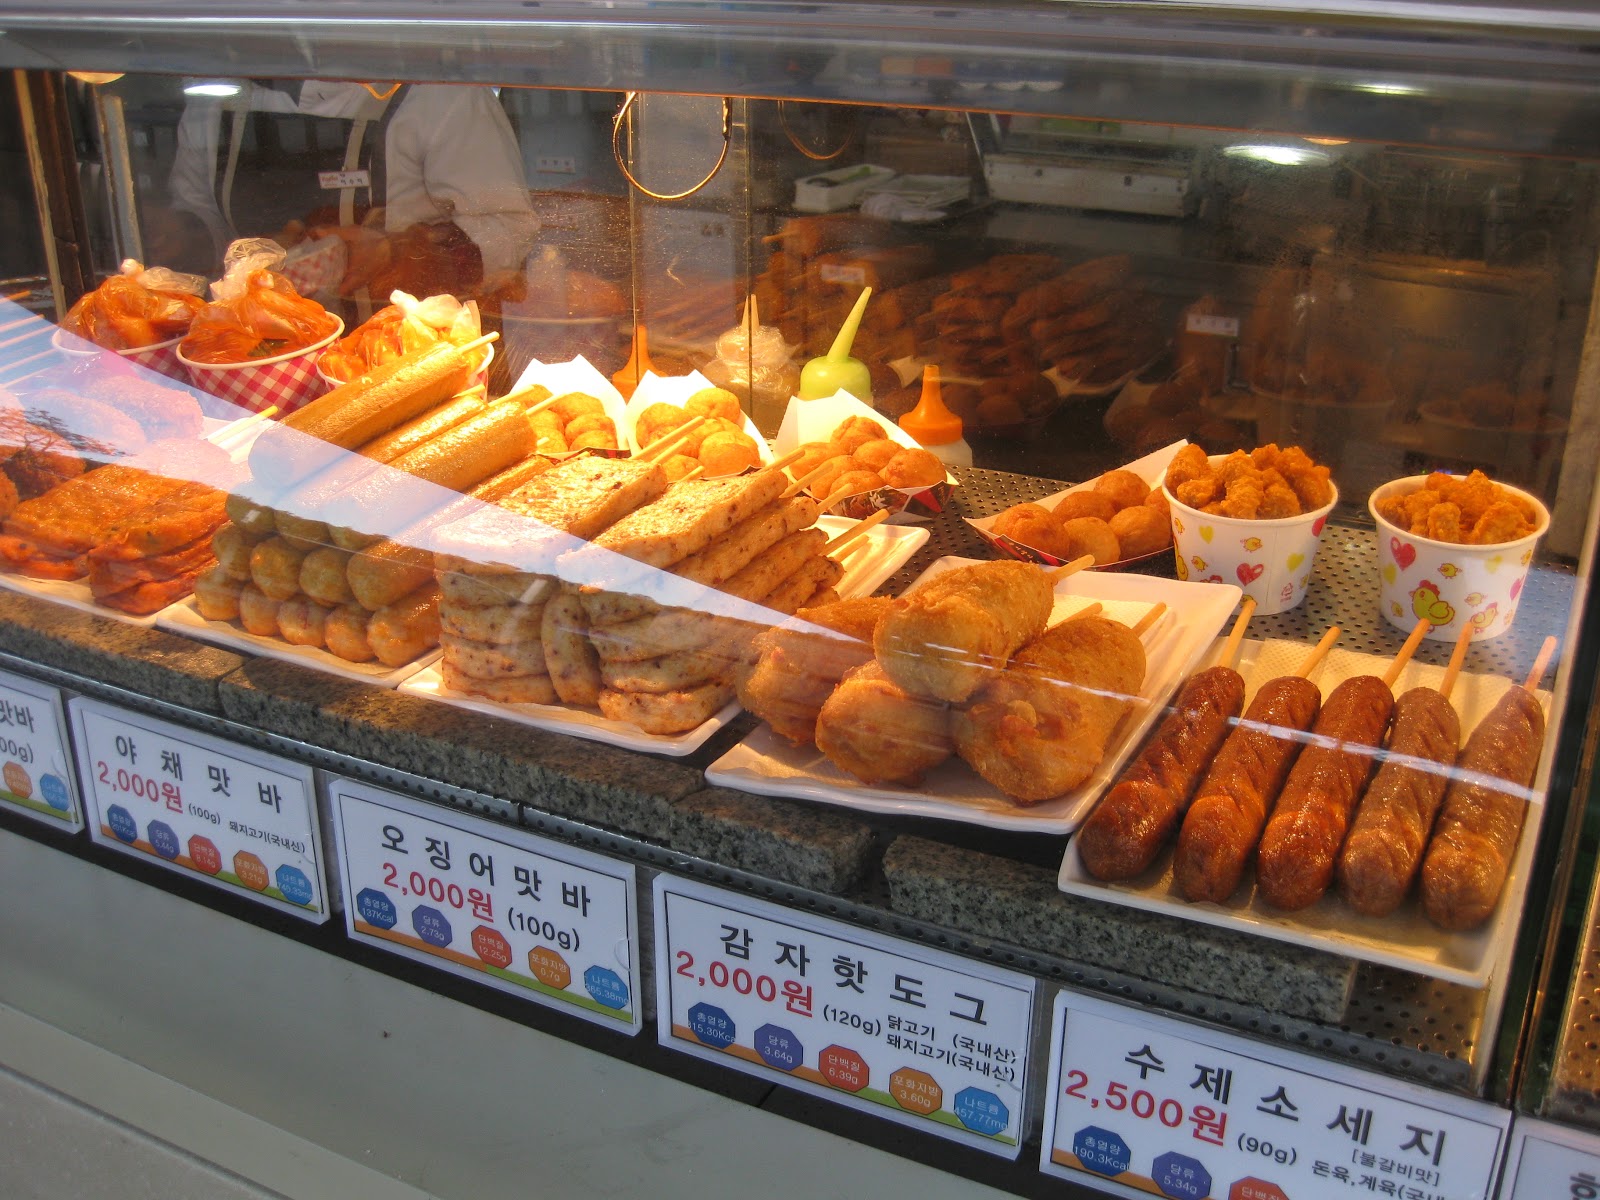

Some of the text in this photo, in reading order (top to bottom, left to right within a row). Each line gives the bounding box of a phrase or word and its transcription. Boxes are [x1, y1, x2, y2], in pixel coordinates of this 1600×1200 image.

[97, 760, 183, 814] 2,000원
[188, 803, 221, 825] (100g)
[383, 862, 494, 923] 2,000원
[361, 907, 394, 923] 137Kcal
[422, 915, 440, 928] 당류
[421, 925, 445, 941] 2.73g
[508, 906, 580, 952] (100g)
[478, 934, 504, 950] 단백질
[478, 946, 507, 963] 12.25g
[532, 953, 567, 973] 포화지방
[540, 968, 560, 982] 0.7g
[592, 974, 620, 991] 나트륨
[676, 949, 1017, 1065] 2,000원 (120g) 닭고기 (국내산)
[697, 1012, 727, 1029] 총열량
[687, 1019, 736, 1044] 315.30Kca
[768, 1034, 789, 1048] 당류
[764, 1046, 793, 1064] 3.64g
[828, 1054, 861, 1072] 단백질
[886, 1033, 1015, 1082] 돼지고기(국내산)
[828, 1068, 859, 1085] 6.39g
[894, 1074, 939, 1097] 포화지방
[900, 1090, 931, 1108] 3.60g
[964, 1097, 999, 1115] 나트륨
[1065, 1069, 1297, 1166] 2,500원 (90g)
[1085, 1136, 1121, 1155] 총열량
[1074, 1145, 1130, 1170] 190.3Kcal
[1170, 1163, 1194, 1179] 당류
[1351, 1148, 1440, 1187] [불갈비맛]
[1163, 1175, 1198, 1195] 5.34g
